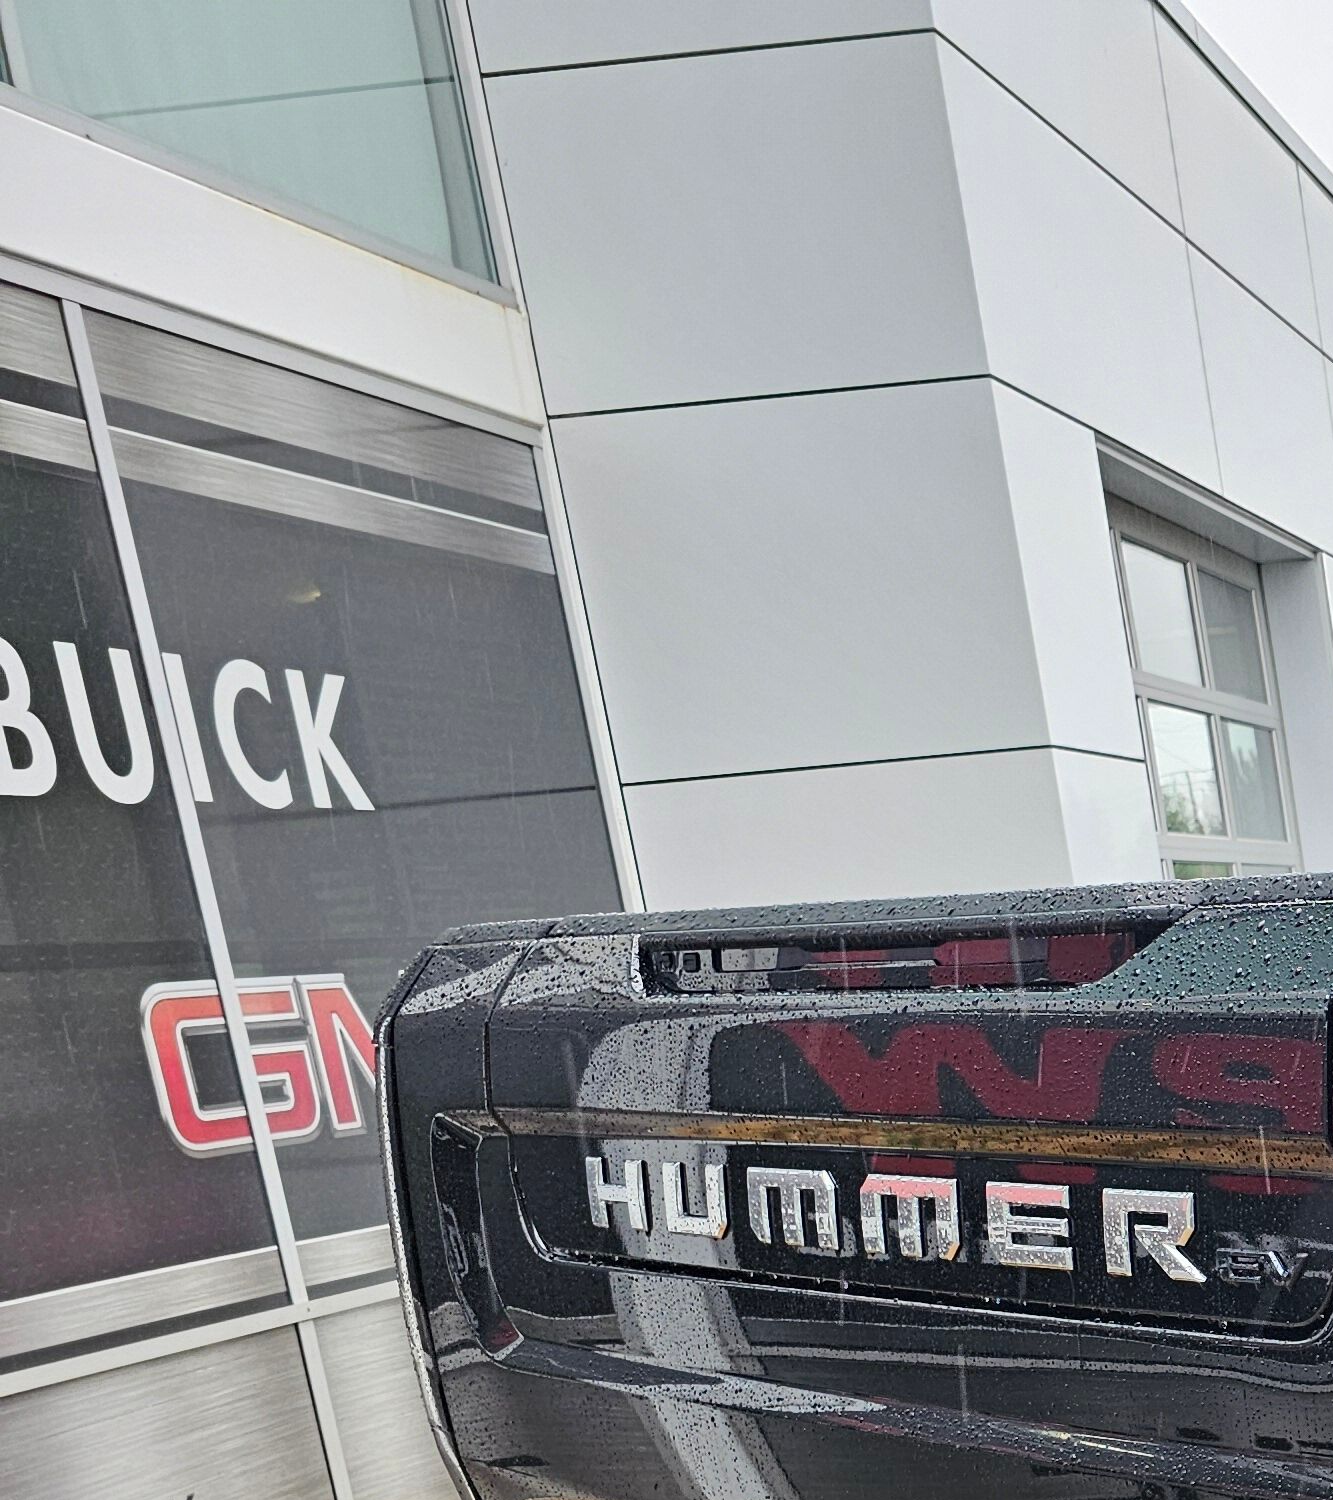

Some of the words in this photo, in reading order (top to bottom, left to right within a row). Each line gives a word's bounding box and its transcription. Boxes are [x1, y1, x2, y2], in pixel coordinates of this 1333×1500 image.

[0, 638, 375, 811] BUICK
[585, 1156, 1207, 1284] HUMMER
[1216, 1246, 1307, 1287] EV
